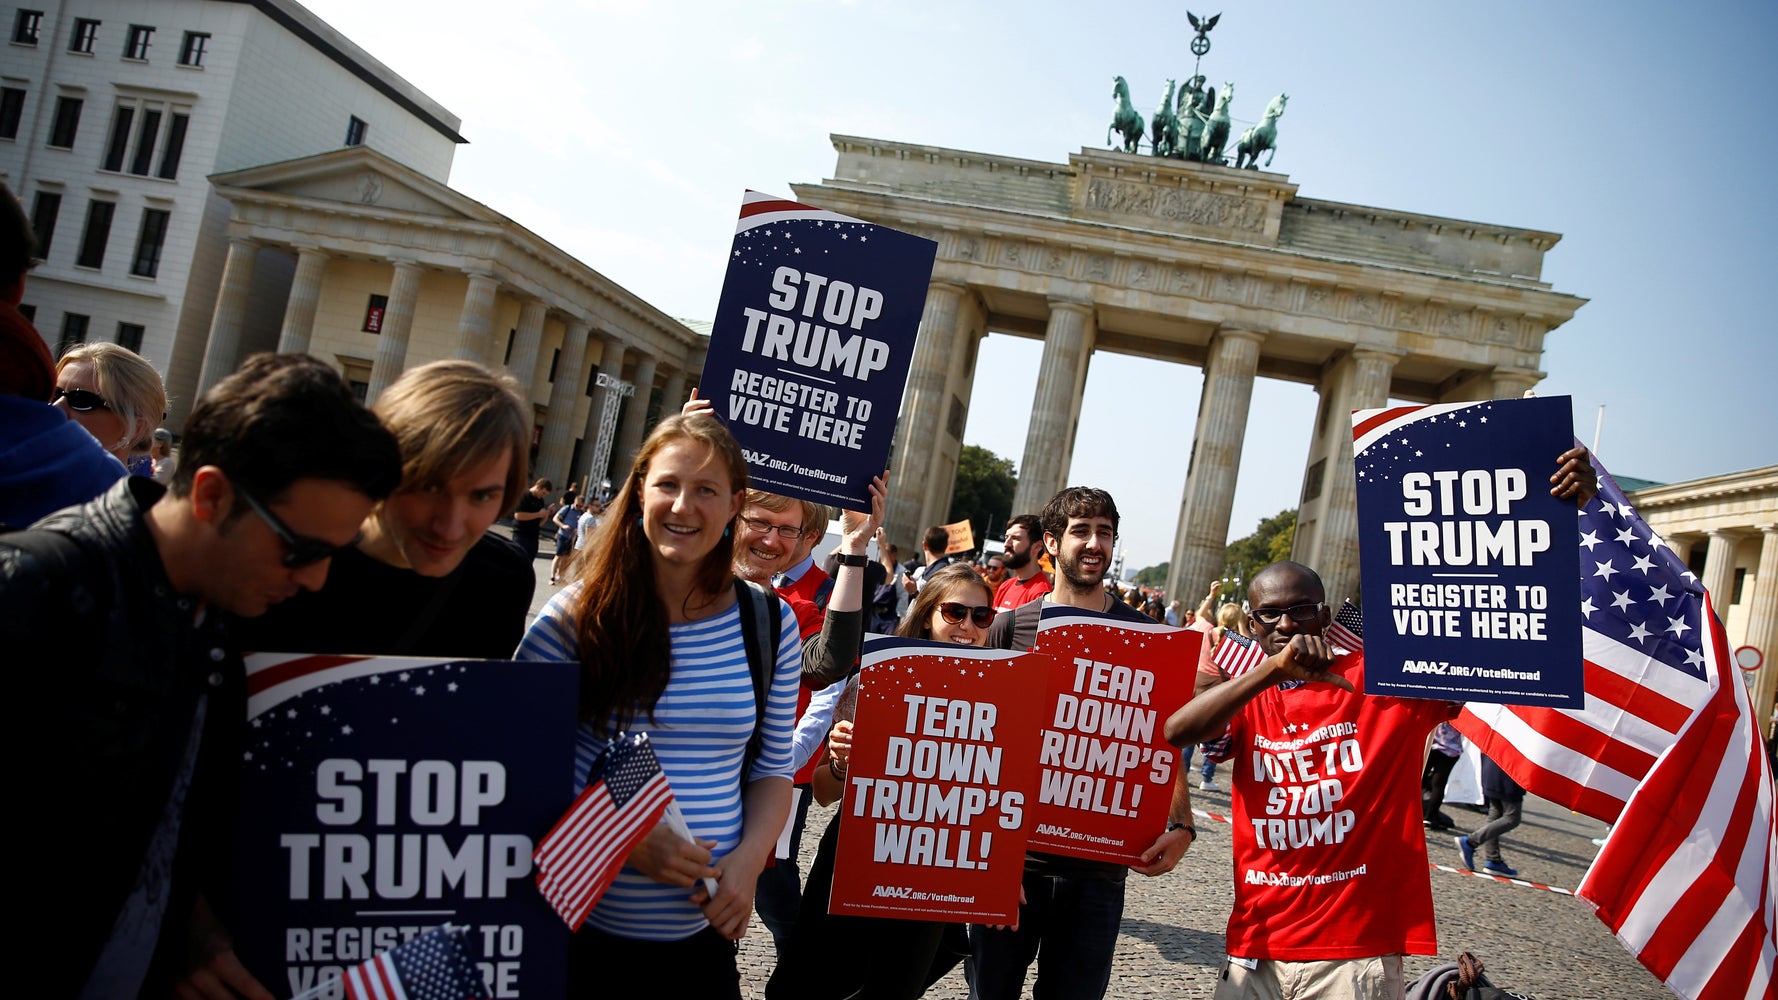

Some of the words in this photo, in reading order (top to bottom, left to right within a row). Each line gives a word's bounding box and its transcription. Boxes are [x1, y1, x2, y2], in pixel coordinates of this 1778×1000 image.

[768, 265, 884, 330] STOP
[741, 307, 890, 381] TRUMP
[730, 368, 839, 415] REGISTER
[845, 395, 873, 423] TO
[728, 394, 795, 433] VOTE
[798, 411, 866, 450] HERE
[741, 449, 848, 485] AAZ.ORG/VoteAbroad
[1402, 468, 1527, 516] STOP
[1383, 519, 1551, 566] TRUMP
[1390, 583, 1507, 610] REGISTER
[1515, 584, 1547, 610] TO
[1392, 609, 1462, 638] VOTE
[1471, 611, 1548, 641] HERE
[1073, 657, 1155, 706] TEAR
[903, 694, 997, 742] TEAR
[1053, 693, 1157, 745] DOWN
[1254, 733, 1304, 750] ERICANS
[884, 736, 1002, 786] DOWN
[1039, 729, 1173, 785] RUMP'S
[1253, 748, 1320, 784] VOTE
[1320, 738, 1364, 776] TO
[315, 758, 507, 826] STOP
[851, 776, 1025, 831] TRUMP'S
[1038, 768, 1143, 819] WALL!
[1265, 778, 1344, 816] STOP
[873, 823, 992, 870] WALL!
[1251, 809, 1355, 851] TRUMP
[279, 833, 534, 900] TRUMP
[286, 926, 463, 961] REGIST
[480, 925, 523, 957] TO
